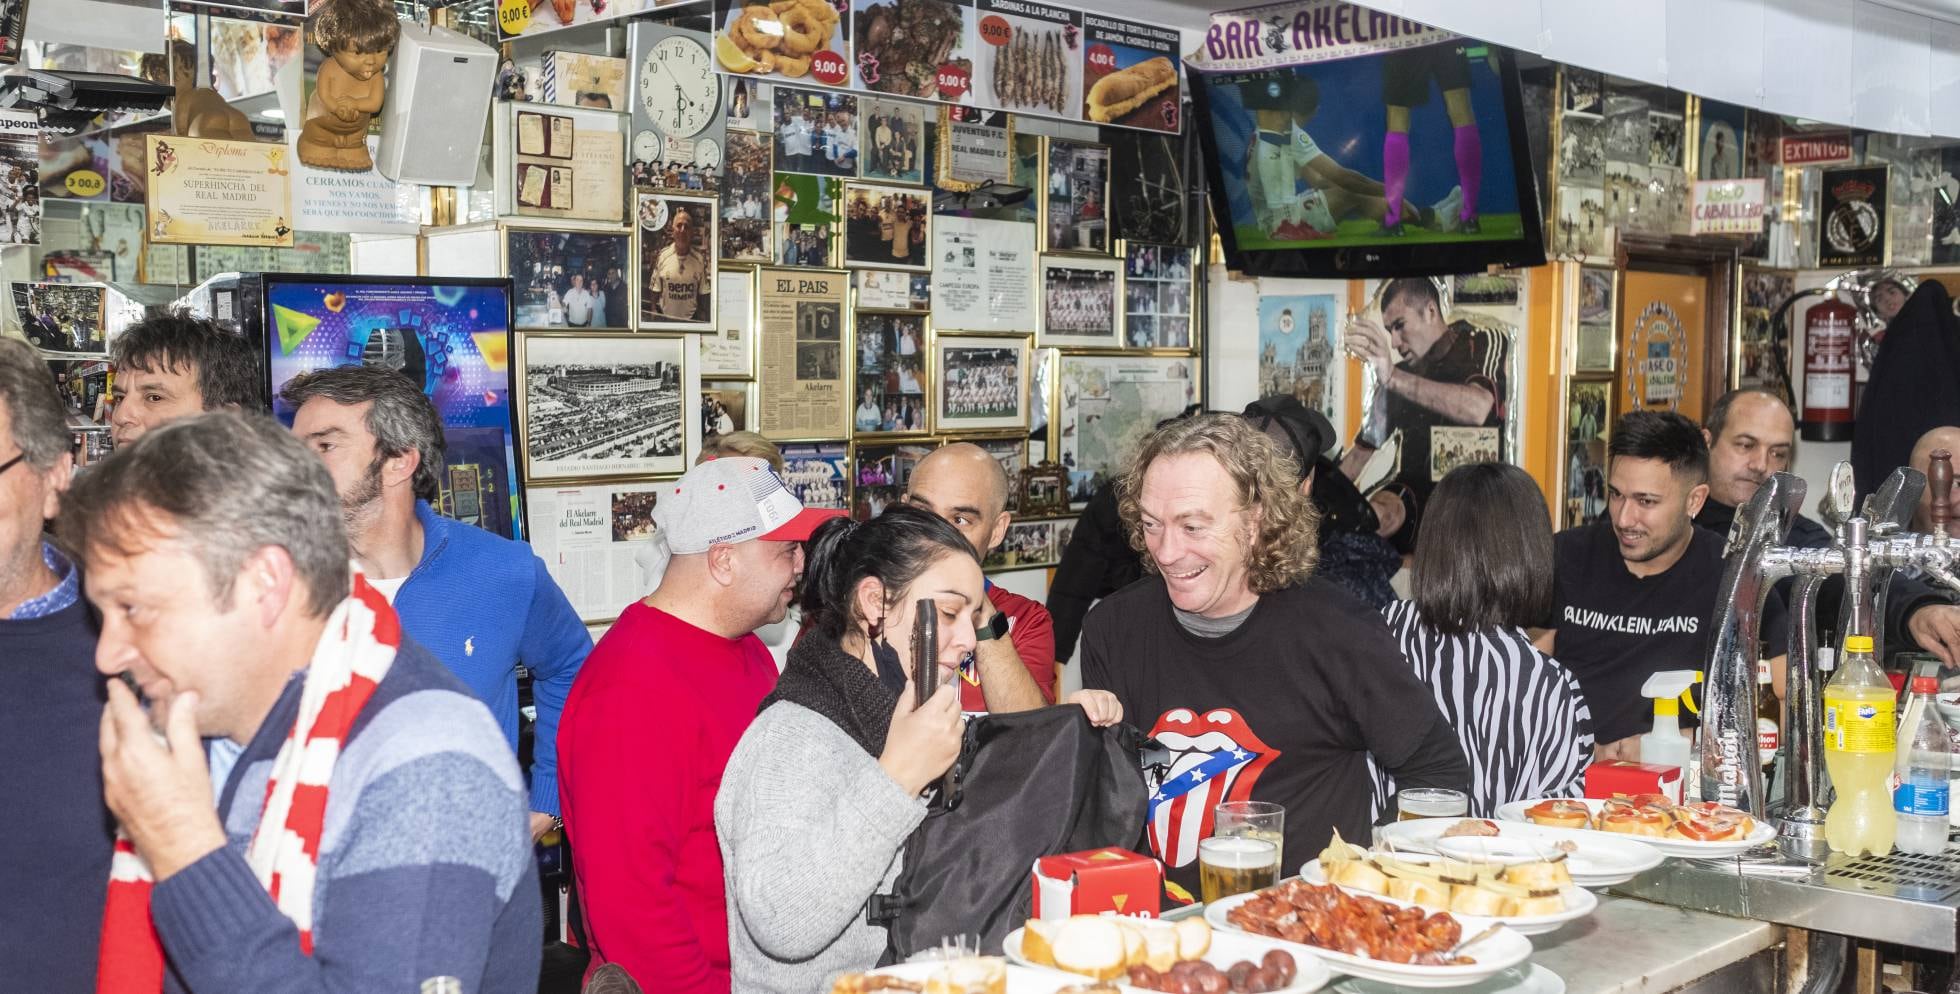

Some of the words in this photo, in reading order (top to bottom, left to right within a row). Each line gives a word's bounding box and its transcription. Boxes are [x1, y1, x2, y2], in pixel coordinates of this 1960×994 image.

[502, 8, 520, 24] 9,00
[522, 6, 528, 18] €
[990, 0, 1024, 13] SARDINAS
[1024, 6, 1031, 14] A
[1031, 7, 1040, 15] LA
[1041, 8, 1070, 21] PLANCHA
[983, 24, 1001, 36] 9,00
[1086, 17, 1118, 31] BOCADILLO
[1119, 22, 1126, 32] DE
[1126, 24, 1152, 36] TORTILLA
[1152, 29, 1179, 41] FRANCESA
[1096, 31, 1104, 39] DE
[1126, 36, 1150, 47] CHORIZO
[1206, 20, 1264, 60] BAR
[661, 50, 668, 60] 11
[675, 46, 683, 57] 12
[692, 54, 696, 64] 1
[648, 62, 657, 73] 10
[814, 60, 836, 73] 9,00
[838, 64, 845, 75] €
[701, 69, 706, 79] 2
[643, 79, 649, 88] 9
[939, 74, 958, 87] 9,00
[704, 87, 710, 97] 3
[647, 97, 652, 107] 8
[699, 104, 704, 114] 4
[658, 110, 663, 120] 7
[688, 115, 693, 125] 5
[673, 118, 678, 128] 6
[952, 125, 990, 137] JUVENTUS
[199, 142, 248, 159] Diploma
[952, 145, 967, 153] REAL
[969, 146, 995, 156] MADRID
[183, 180, 246, 192] SUPERHINCHA
[250, 183, 267, 192] DEL
[306, 176, 366, 188] CERRAMOS
[195, 190, 217, 200] REAL
[222, 192, 257, 201] MADRID
[329, 190, 348, 198] NOS
[776, 279, 795, 293] EL
[798, 280, 829, 294] PAIS
[804, 383, 833, 392] Akelarre
[487, 468, 493, 478] 5
[488, 482, 494, 492] 2
[566, 509, 573, 518] El
[573, 509, 597, 518] Akelarre
[560, 520, 568, 528] del
[569, 518, 582, 527] Real
[583, 518, 604, 526] Madrid
[736, 525, 757, 536] MADRID
[1758, 736, 1776, 744] hou
